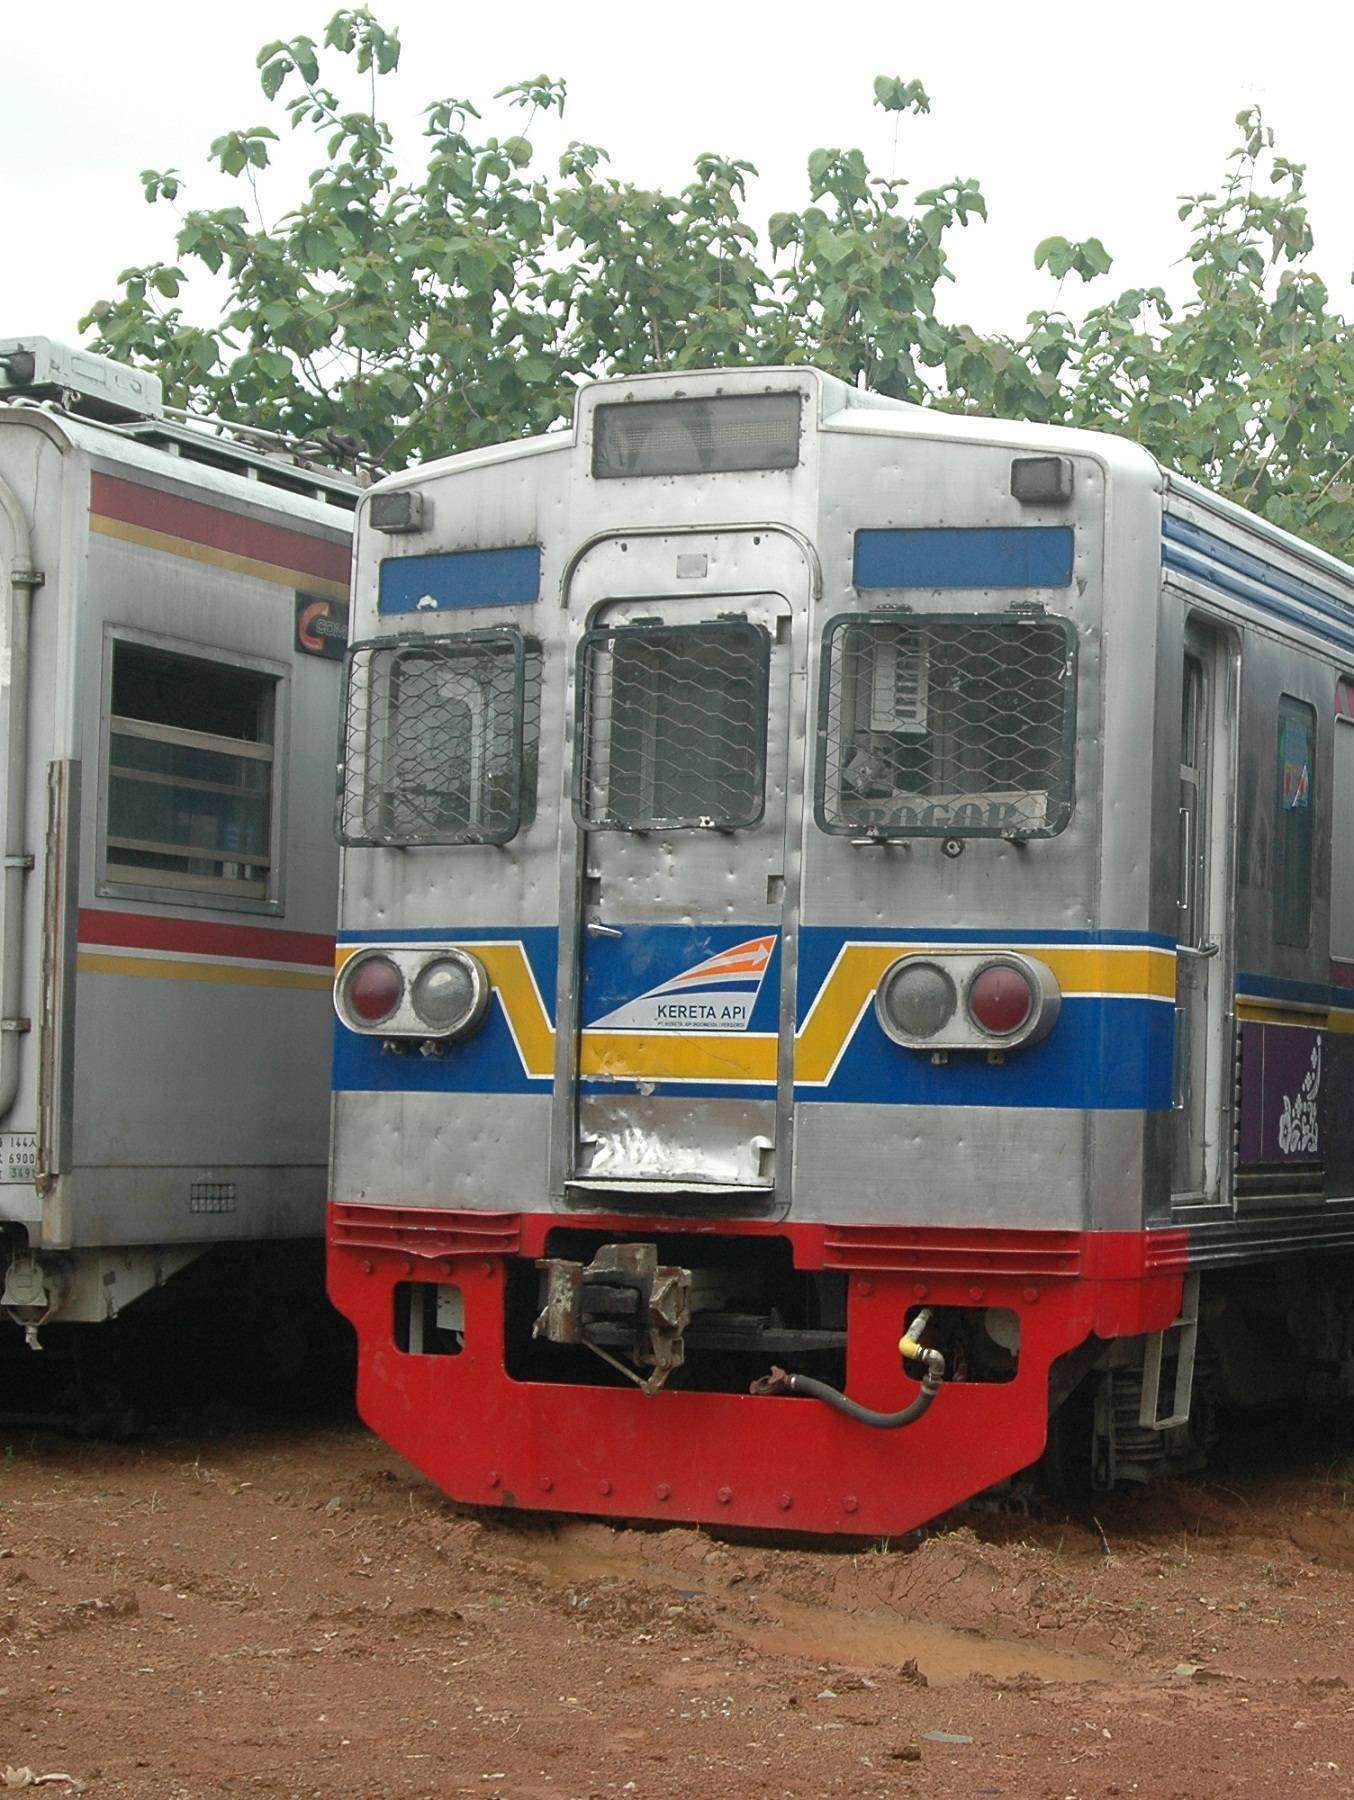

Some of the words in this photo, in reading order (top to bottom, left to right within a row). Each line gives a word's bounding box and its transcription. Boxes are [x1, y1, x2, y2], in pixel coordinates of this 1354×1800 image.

[657, 1004, 716, 1019] KERETA
[721, 1005, 746, 1020] API
[9, 1152, 35, 1164] 6900
